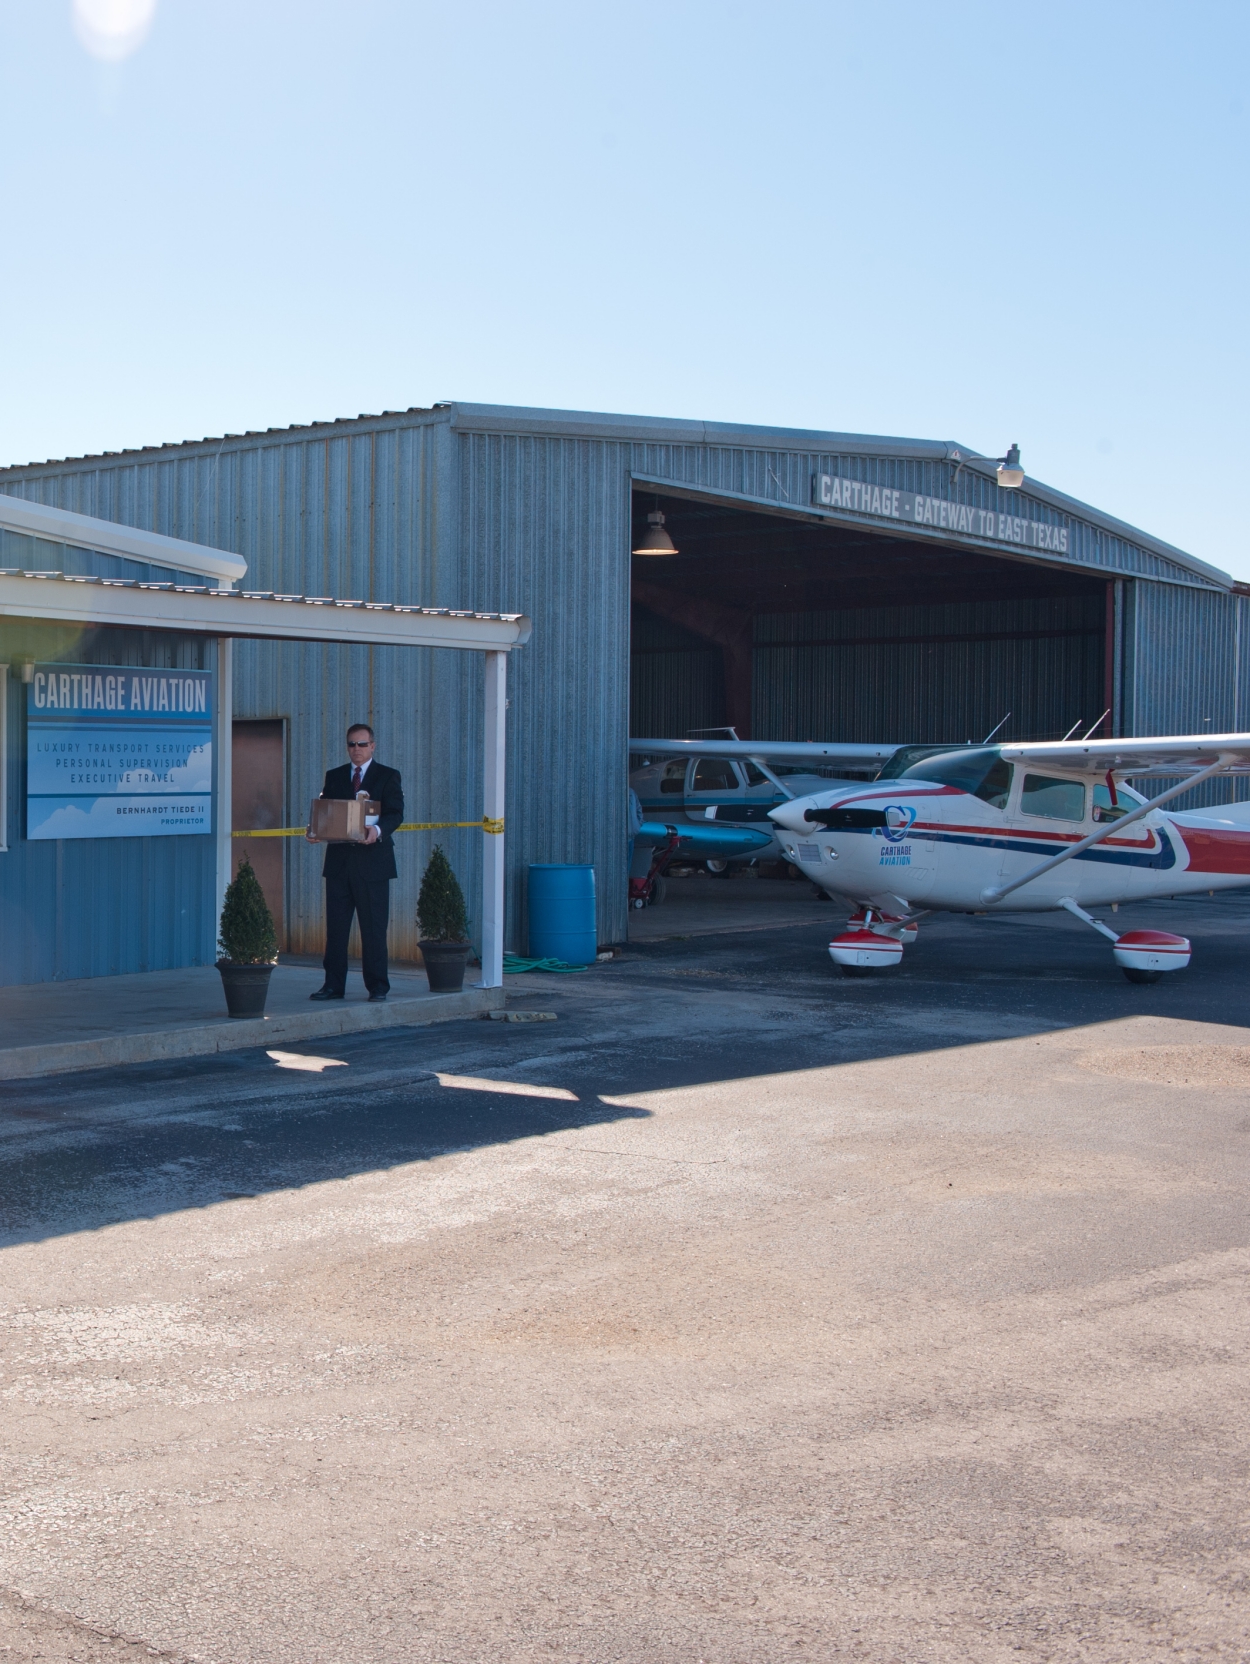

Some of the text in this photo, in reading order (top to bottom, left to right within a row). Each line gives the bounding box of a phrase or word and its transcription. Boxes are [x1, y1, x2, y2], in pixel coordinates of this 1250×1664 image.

[821, 475, 900, 517] CARTHAGE
[914, 495, 975, 533] GATEWAY
[979, 510, 995, 537] TO
[998, 514, 1028, 543] EAST
[1031, 522, 1067, 552] TEXAS
[34, 672, 206, 713] CARTHAGE AVIATION
[37, 743, 204, 754] LUXURY TRANSPORT SERVICES
[56, 758, 188, 768] PERSONAL SUPERVISION
[71, 773, 175, 783] EXECUTIVE TRAVEL
[116, 805, 204, 815] BERNHARDT TIEDE II
[879, 846, 912, 866] CARTHAGE AVIATION
